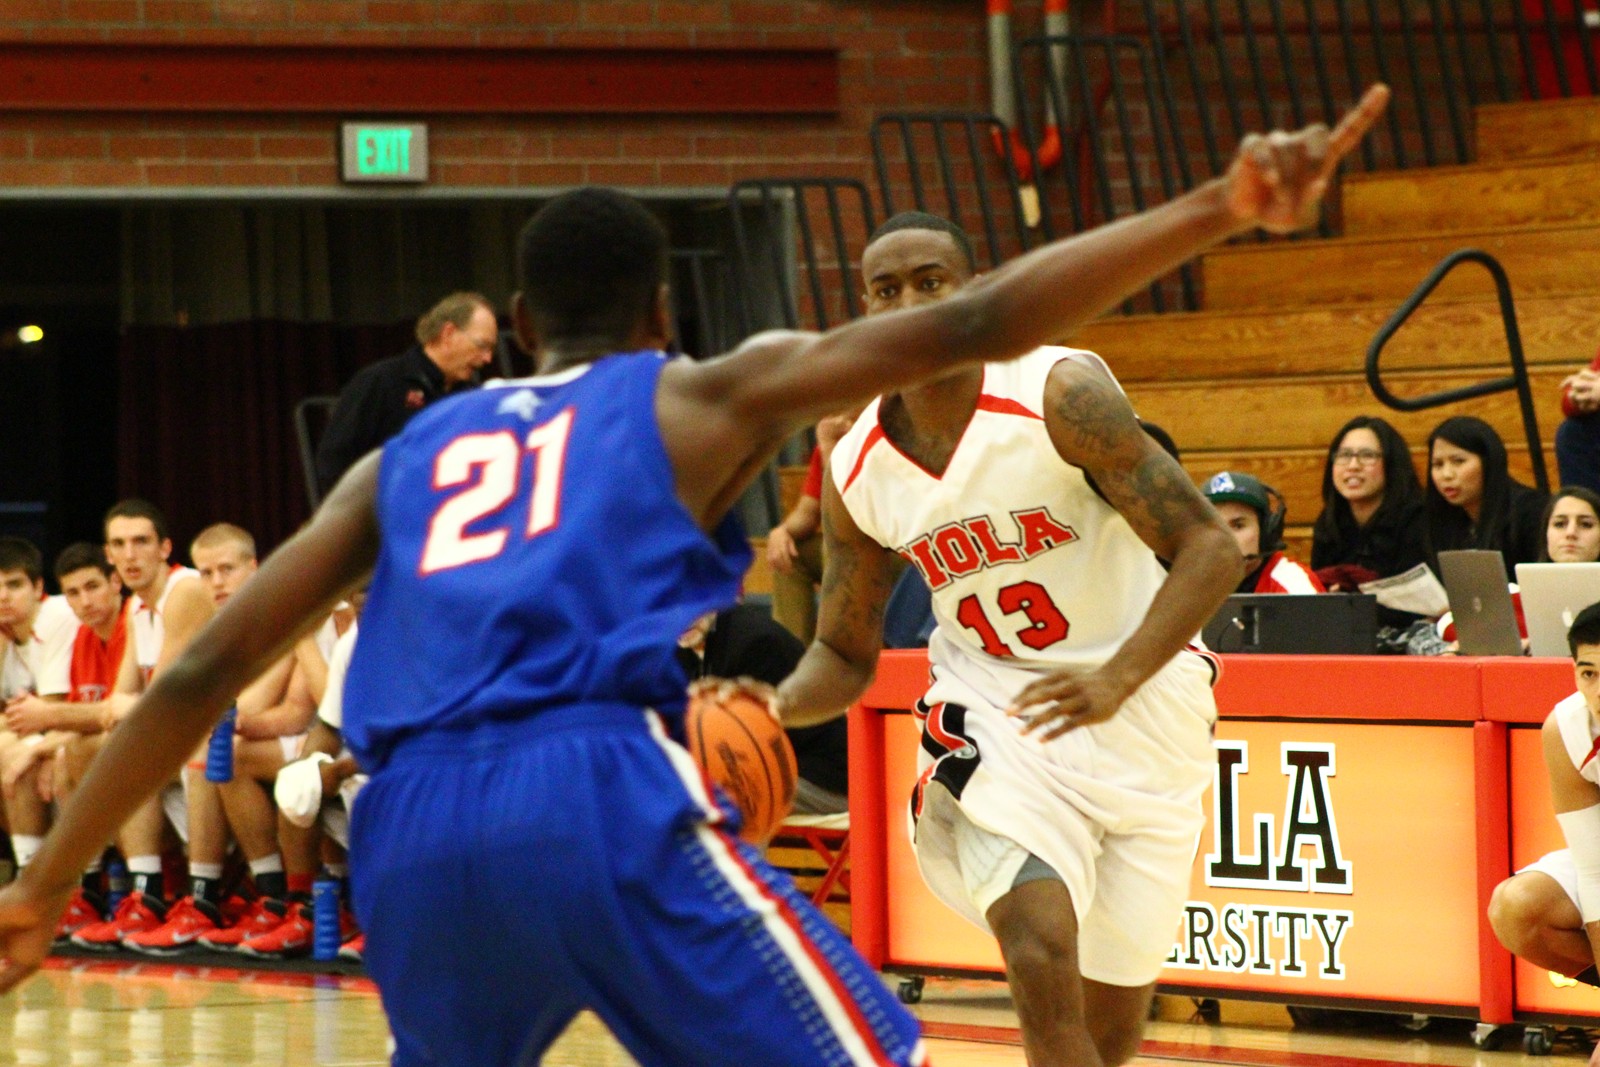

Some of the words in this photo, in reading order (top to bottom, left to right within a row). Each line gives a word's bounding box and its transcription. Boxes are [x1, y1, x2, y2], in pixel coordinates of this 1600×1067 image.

[357, 129, 412, 175] EXIT
[418, 405, 577, 578] 21
[897, 506, 1079, 592] IOLA
[956, 580, 1070, 657] 13
[1165, 903, 1351, 977] RSITY
